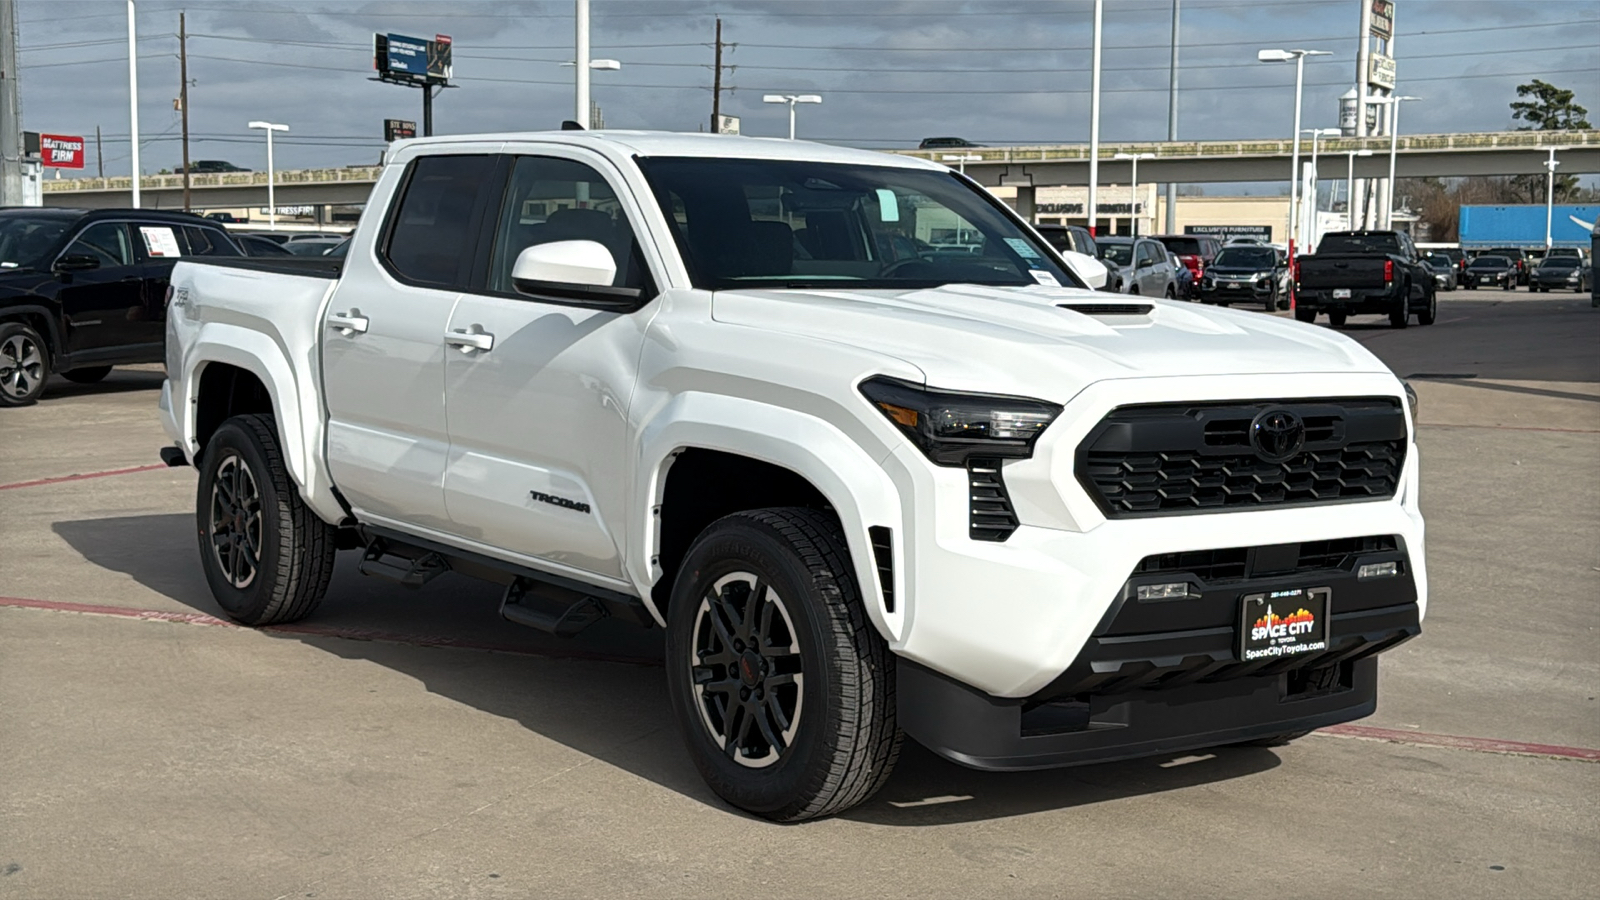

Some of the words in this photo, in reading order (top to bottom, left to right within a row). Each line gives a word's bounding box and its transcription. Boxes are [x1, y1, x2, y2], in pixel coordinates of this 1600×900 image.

[43, 138, 82, 151] MATTRESS
[51, 149, 75, 162] FIRM
[1036, 202, 1084, 214] EXCLUSIVE
[1095, 202, 1143, 214] URNITURE
[529, 490, 591, 514] TACOMA
[1251, 617, 1287, 641] SPACE
[1288, 620, 1315, 635] CITY
[1278, 636, 1296, 644] TOYOTA
[1246, 642, 1325, 659] SpaceCityToyota.com
